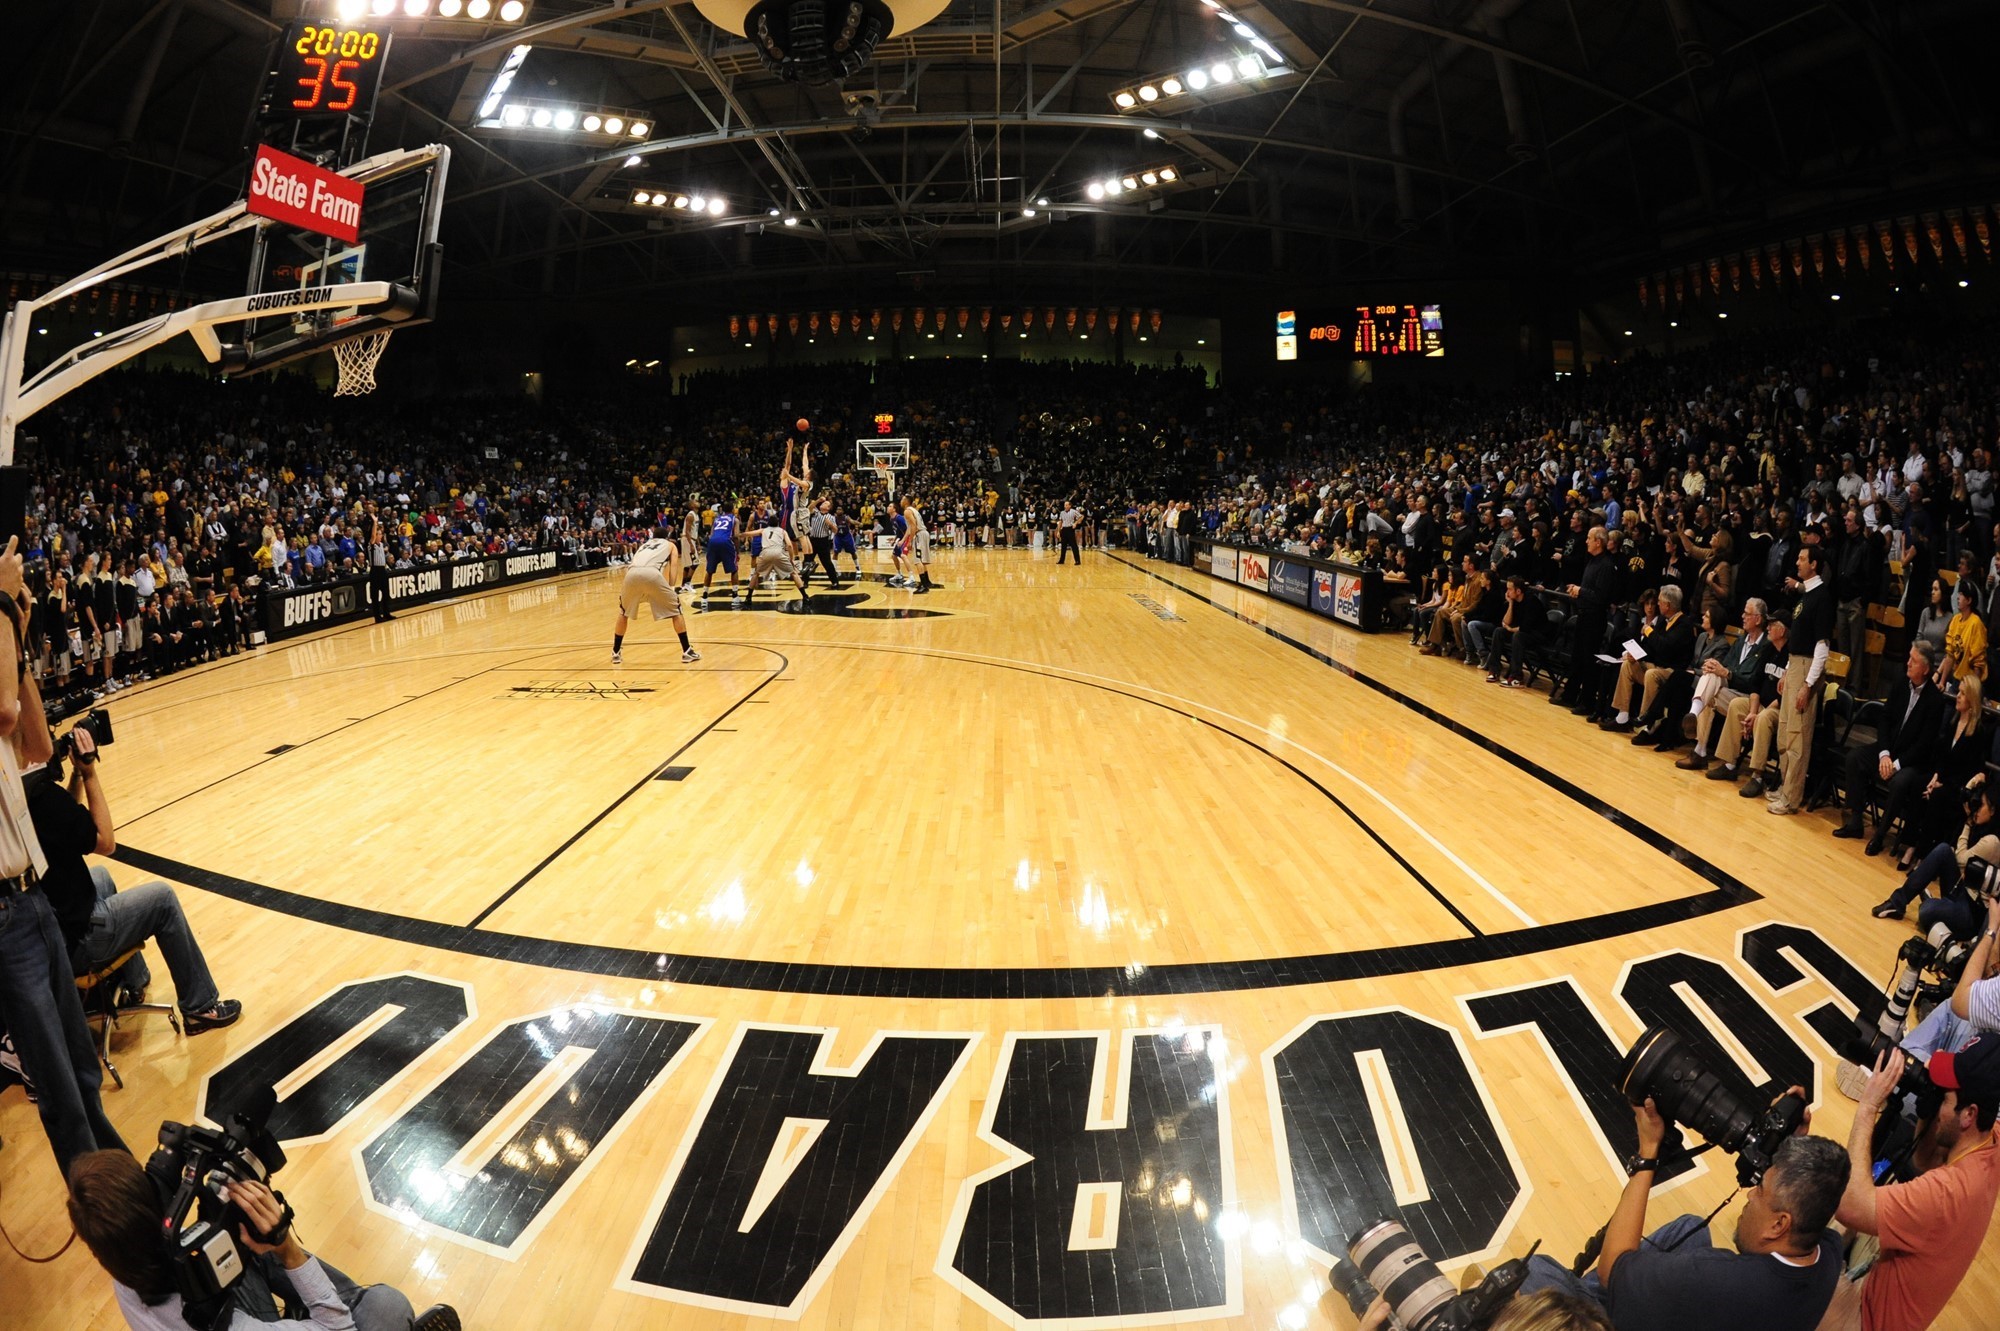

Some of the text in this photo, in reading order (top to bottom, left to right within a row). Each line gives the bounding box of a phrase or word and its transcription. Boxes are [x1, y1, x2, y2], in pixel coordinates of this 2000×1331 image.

[296, 26, 379, 59] 20:00
[293, 57, 359, 110] 35
[252, 157, 360, 228] State Farm
[247, 287, 332, 312] CUBUFFS.COM
[1376, 306, 1396, 314] 20:00
[1310, 328, 1325, 339] GO
[877, 422, 891, 433] 35
[714, 520, 730, 530] 22
[768, 531, 774, 539] 1
[452, 562, 484, 589] BUFFS
[506, 551, 557, 576] CUBUFFS.COM
[1243, 553, 1260, 582] 760
[1314, 569, 1333, 586] PEPSI
[1339, 578, 1353, 602] diet
[284, 590, 332, 627] BUFFS
